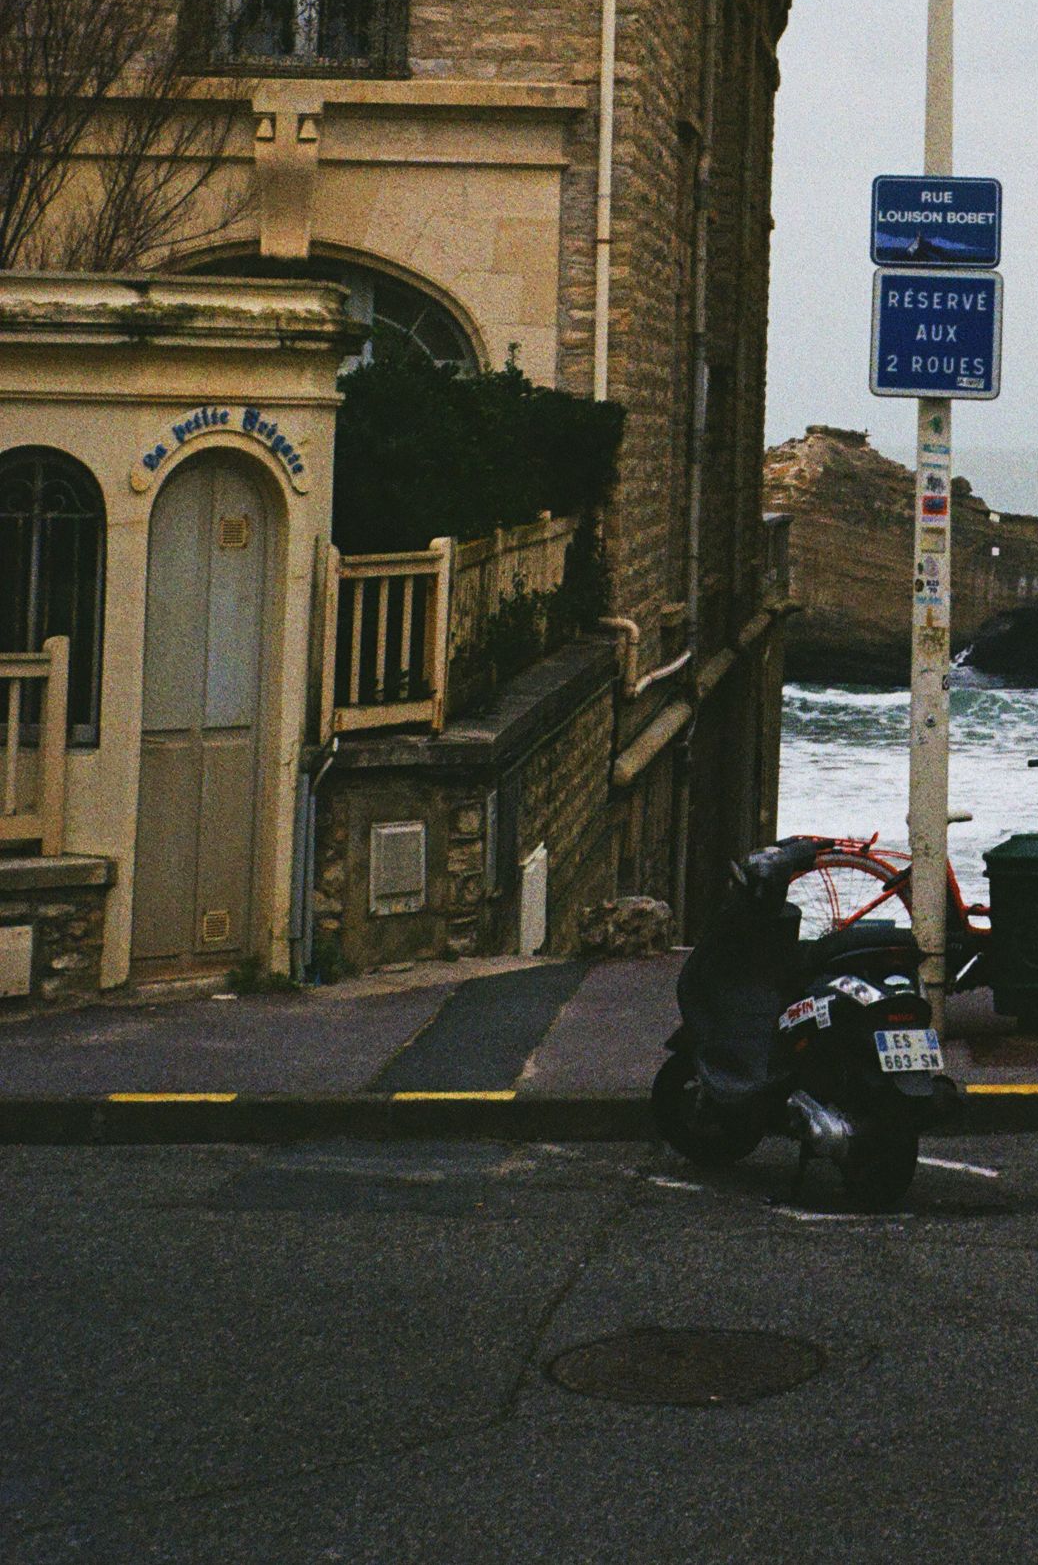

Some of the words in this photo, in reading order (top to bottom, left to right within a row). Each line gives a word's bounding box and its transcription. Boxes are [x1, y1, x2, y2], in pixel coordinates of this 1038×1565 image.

[921, 191, 953, 203] RUE
[878, 210, 943, 223] LOUISON
[947, 211, 996, 224] BOBET
[888, 288, 988, 311] RÉSERVÉ
[915, 324, 957, 342] AUX
[886, 354, 898, 372] 2
[911, 356, 985, 375] ROUES
[172, 406, 230, 444] petite
